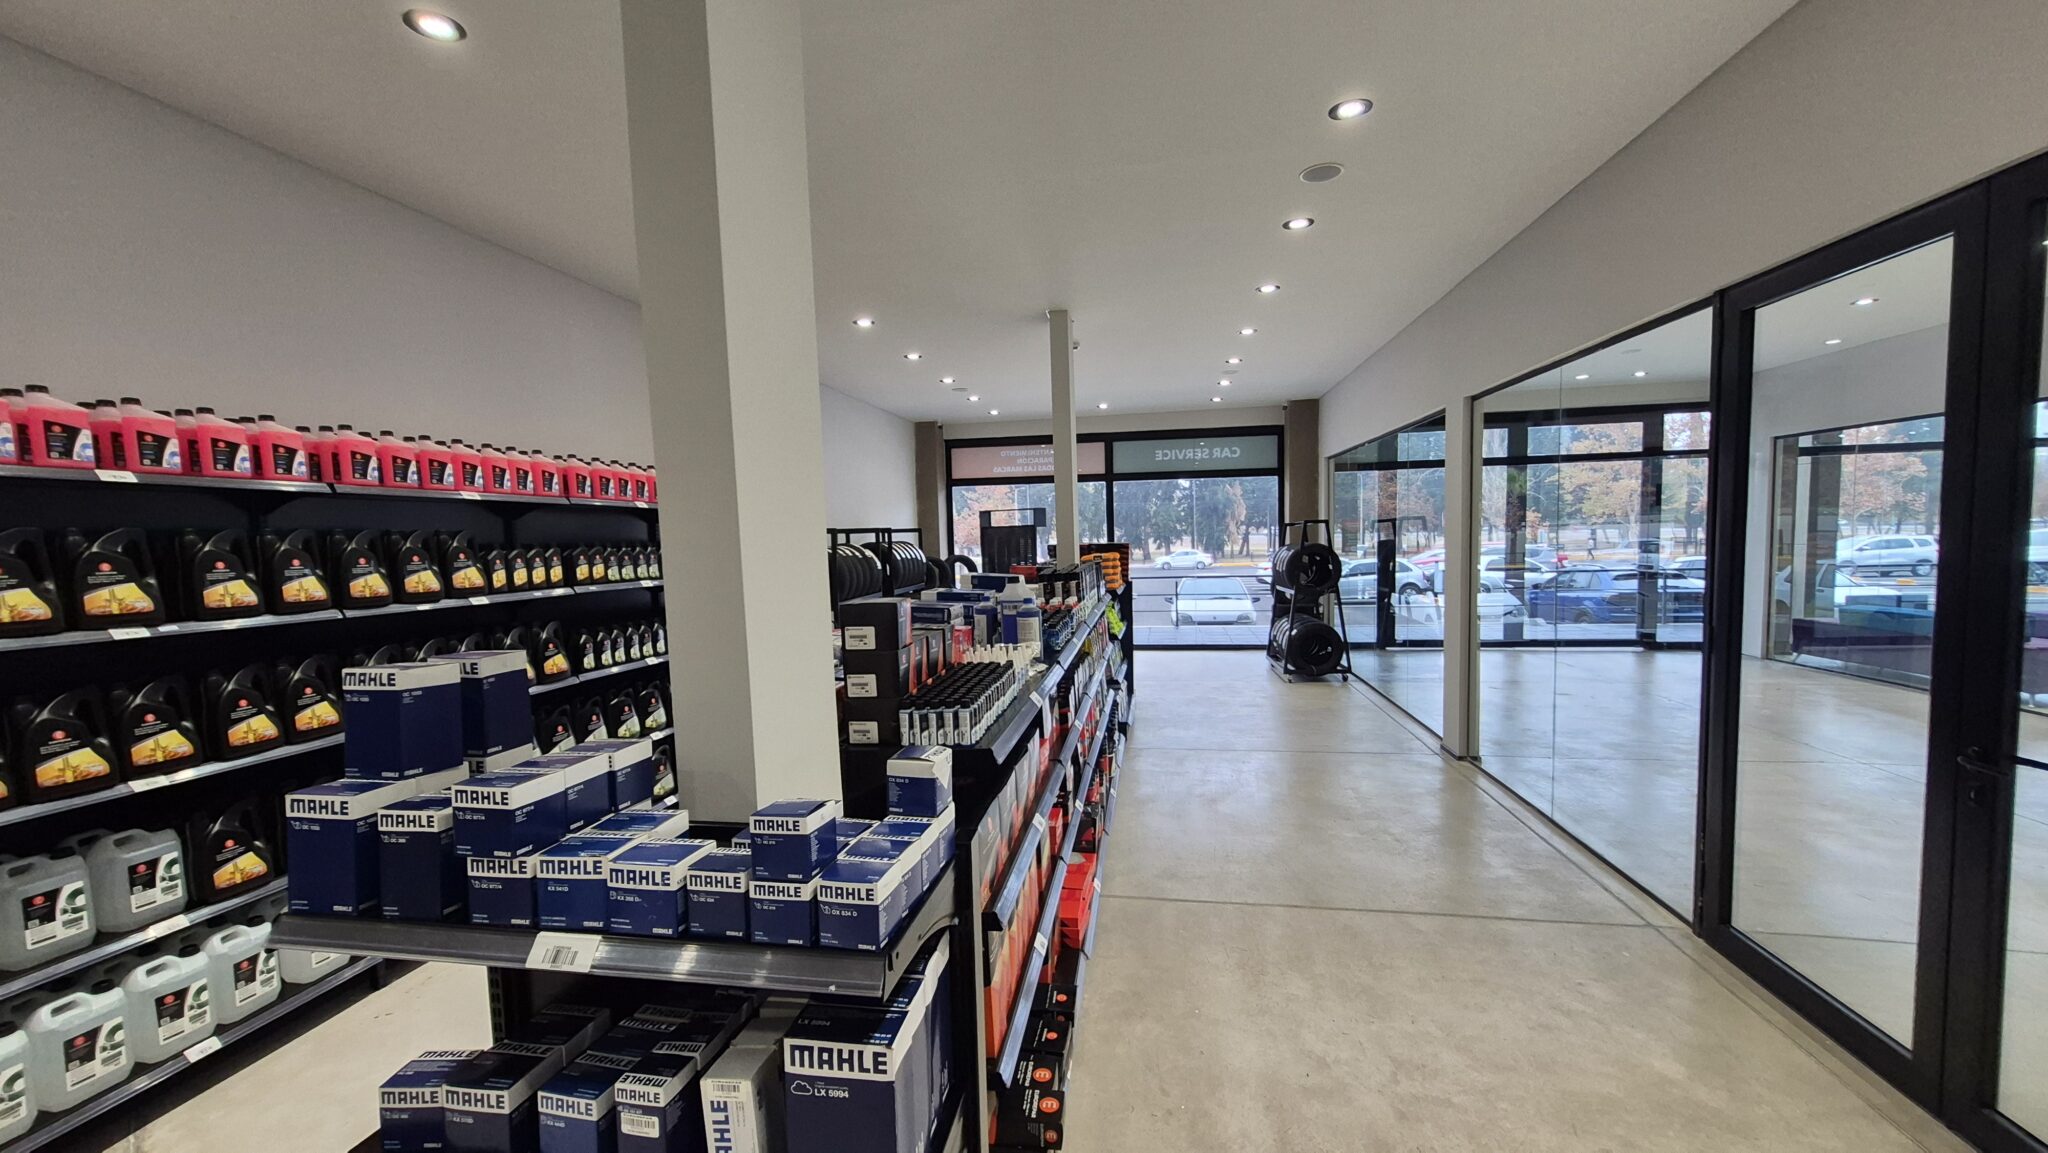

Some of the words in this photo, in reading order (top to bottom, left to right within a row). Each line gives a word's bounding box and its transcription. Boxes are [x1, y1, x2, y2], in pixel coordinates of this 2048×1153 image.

[343, 672, 396, 687] MAHLE
[454, 789, 509, 806] MAHLE
[290, 798, 349, 816] MAHLE
[380, 814, 435, 829] MAHLE
[753, 819, 800, 832] MAHLE
[470, 859, 528, 875] MAHLE
[540, 860, 603, 875] MAHLE
[609, 868, 671, 887] MAHLE
[689, 874, 742, 889] MAHLE
[753, 884, 801, 898] MAHLE
[819, 885, 875, 901] MAHLE
[419, 1050, 478, 1059] MAHLE
[492, 1042, 555, 1056] MAHLE
[789, 1044, 888, 1075] MAHLE
[618, 1074, 668, 1088] MAHLE
[381, 1090, 440, 1105] MAHLE
[445, 1089, 505, 1110] MAHLE
[616, 1088, 661, 1104] MAHLE
[814, 1088, 826, 1097] LX
[828, 1089, 849, 1099] 5994
[540, 1095, 594, 1117] MAHLE
